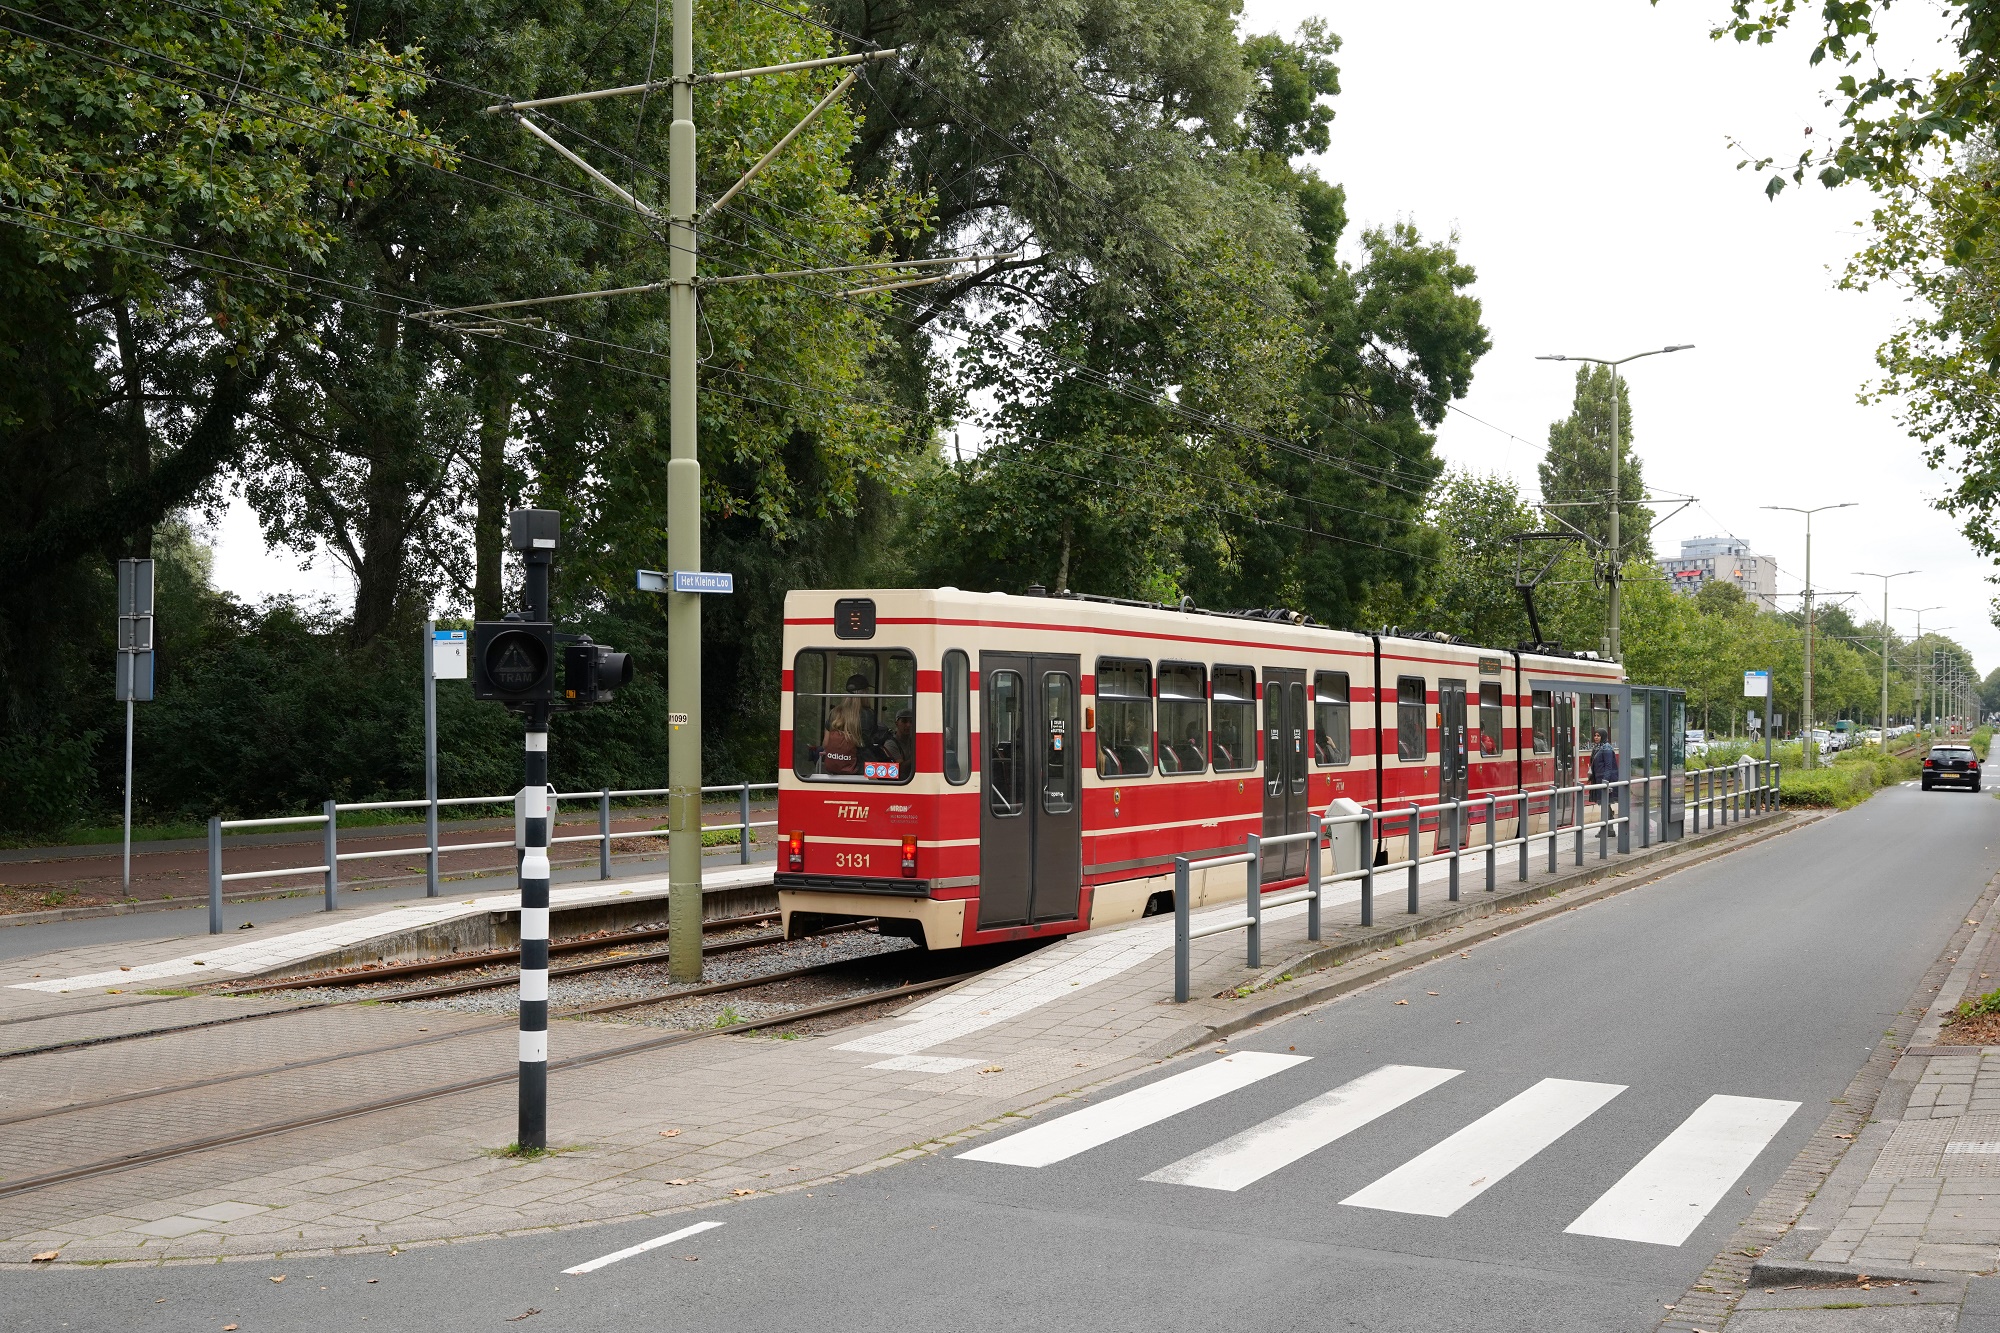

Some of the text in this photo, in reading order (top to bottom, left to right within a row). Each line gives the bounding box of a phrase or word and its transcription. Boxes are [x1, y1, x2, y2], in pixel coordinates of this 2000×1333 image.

[681, 576, 728, 588] Het Kleine Loo
[500, 673, 532, 682] TRAM
[827, 752, 852, 761] adidas
[838, 806, 870, 818] HTM
[836, 853, 870, 868] 3131
